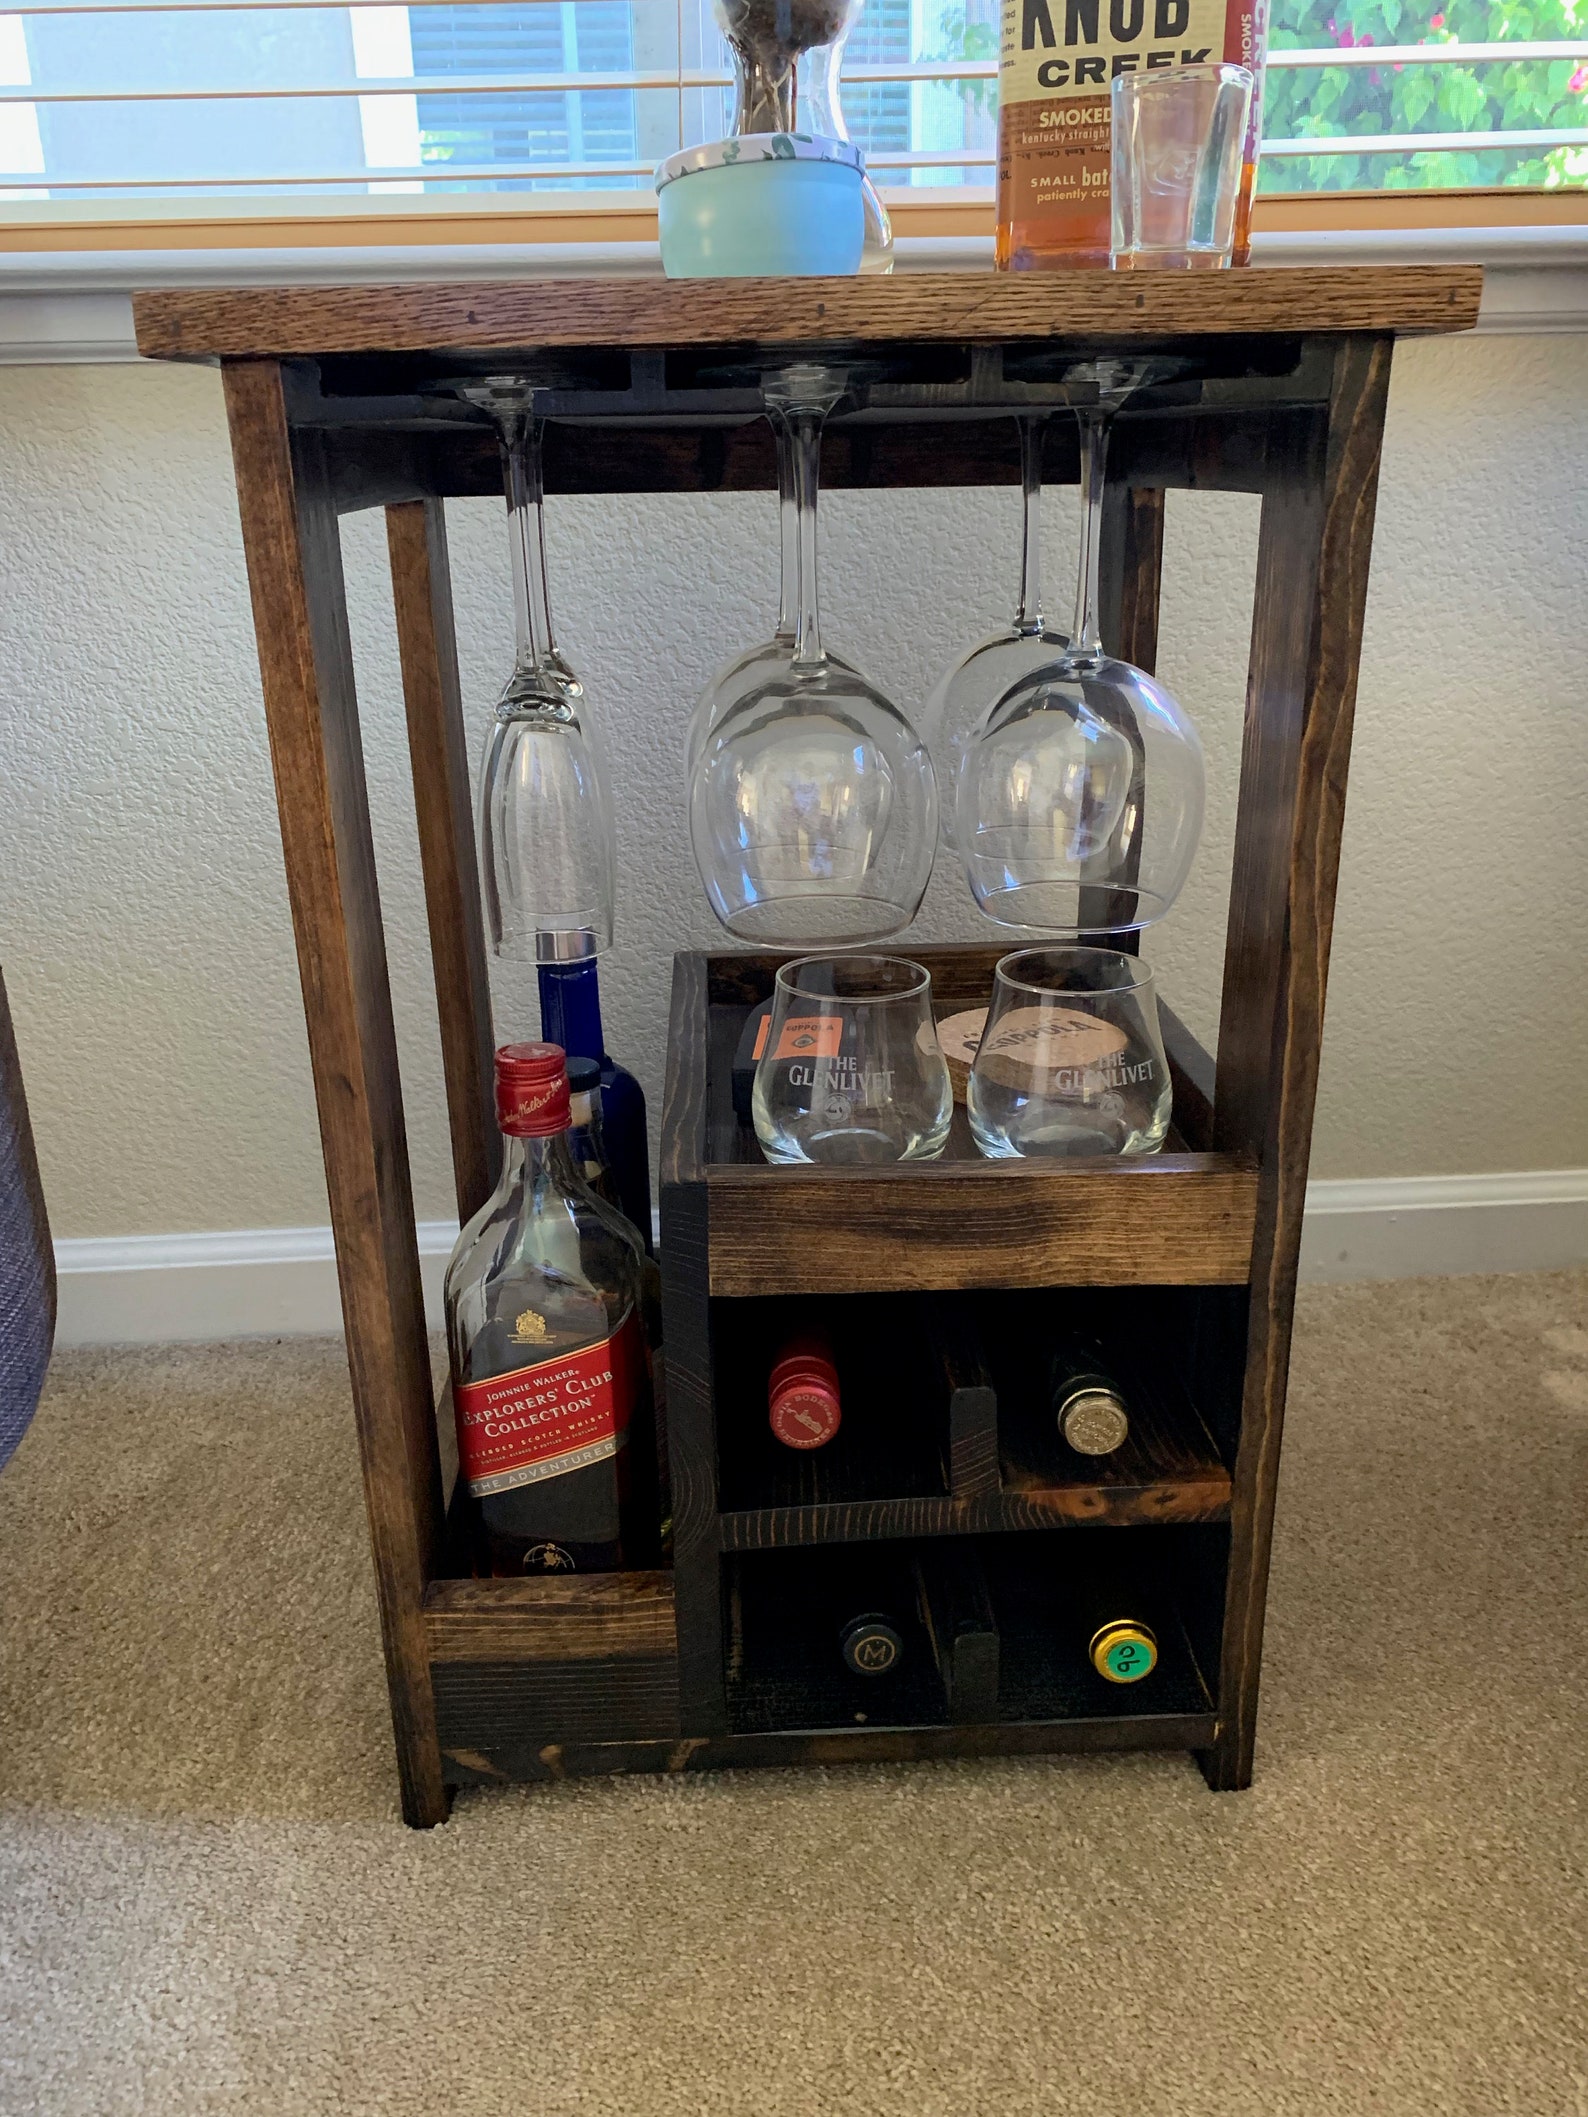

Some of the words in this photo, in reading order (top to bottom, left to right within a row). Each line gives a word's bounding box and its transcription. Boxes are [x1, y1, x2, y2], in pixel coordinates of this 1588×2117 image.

[1022, 128, 1066, 145] kentucky
[1068, 125, 1110, 142] straight
[1030, 174, 1076, 188] SMALL
[1037, 187, 1087, 205] patiently
[827, 1056, 857, 1072] THE
[1098, 1051, 1126, 1067] THE
[789, 1064, 896, 1091] GLENLIVET
[1055, 1060, 1153, 1090] GLENLIVET
[486, 1383, 531, 1404] JOHNNIE
[533, 1369, 576, 1387] WALKER
[565, 1371, 614, 1395] CLUB
[484, 1397, 592, 1437] COLLECTION
[521, 1429, 561, 1446] SCOTCH
[568, 1411, 610, 1430] WHISKY
[471, 1479, 501, 1493] THE
[508, 1443, 615, 1484] ADVENTURER
[863, 1644, 886, 1661] M
